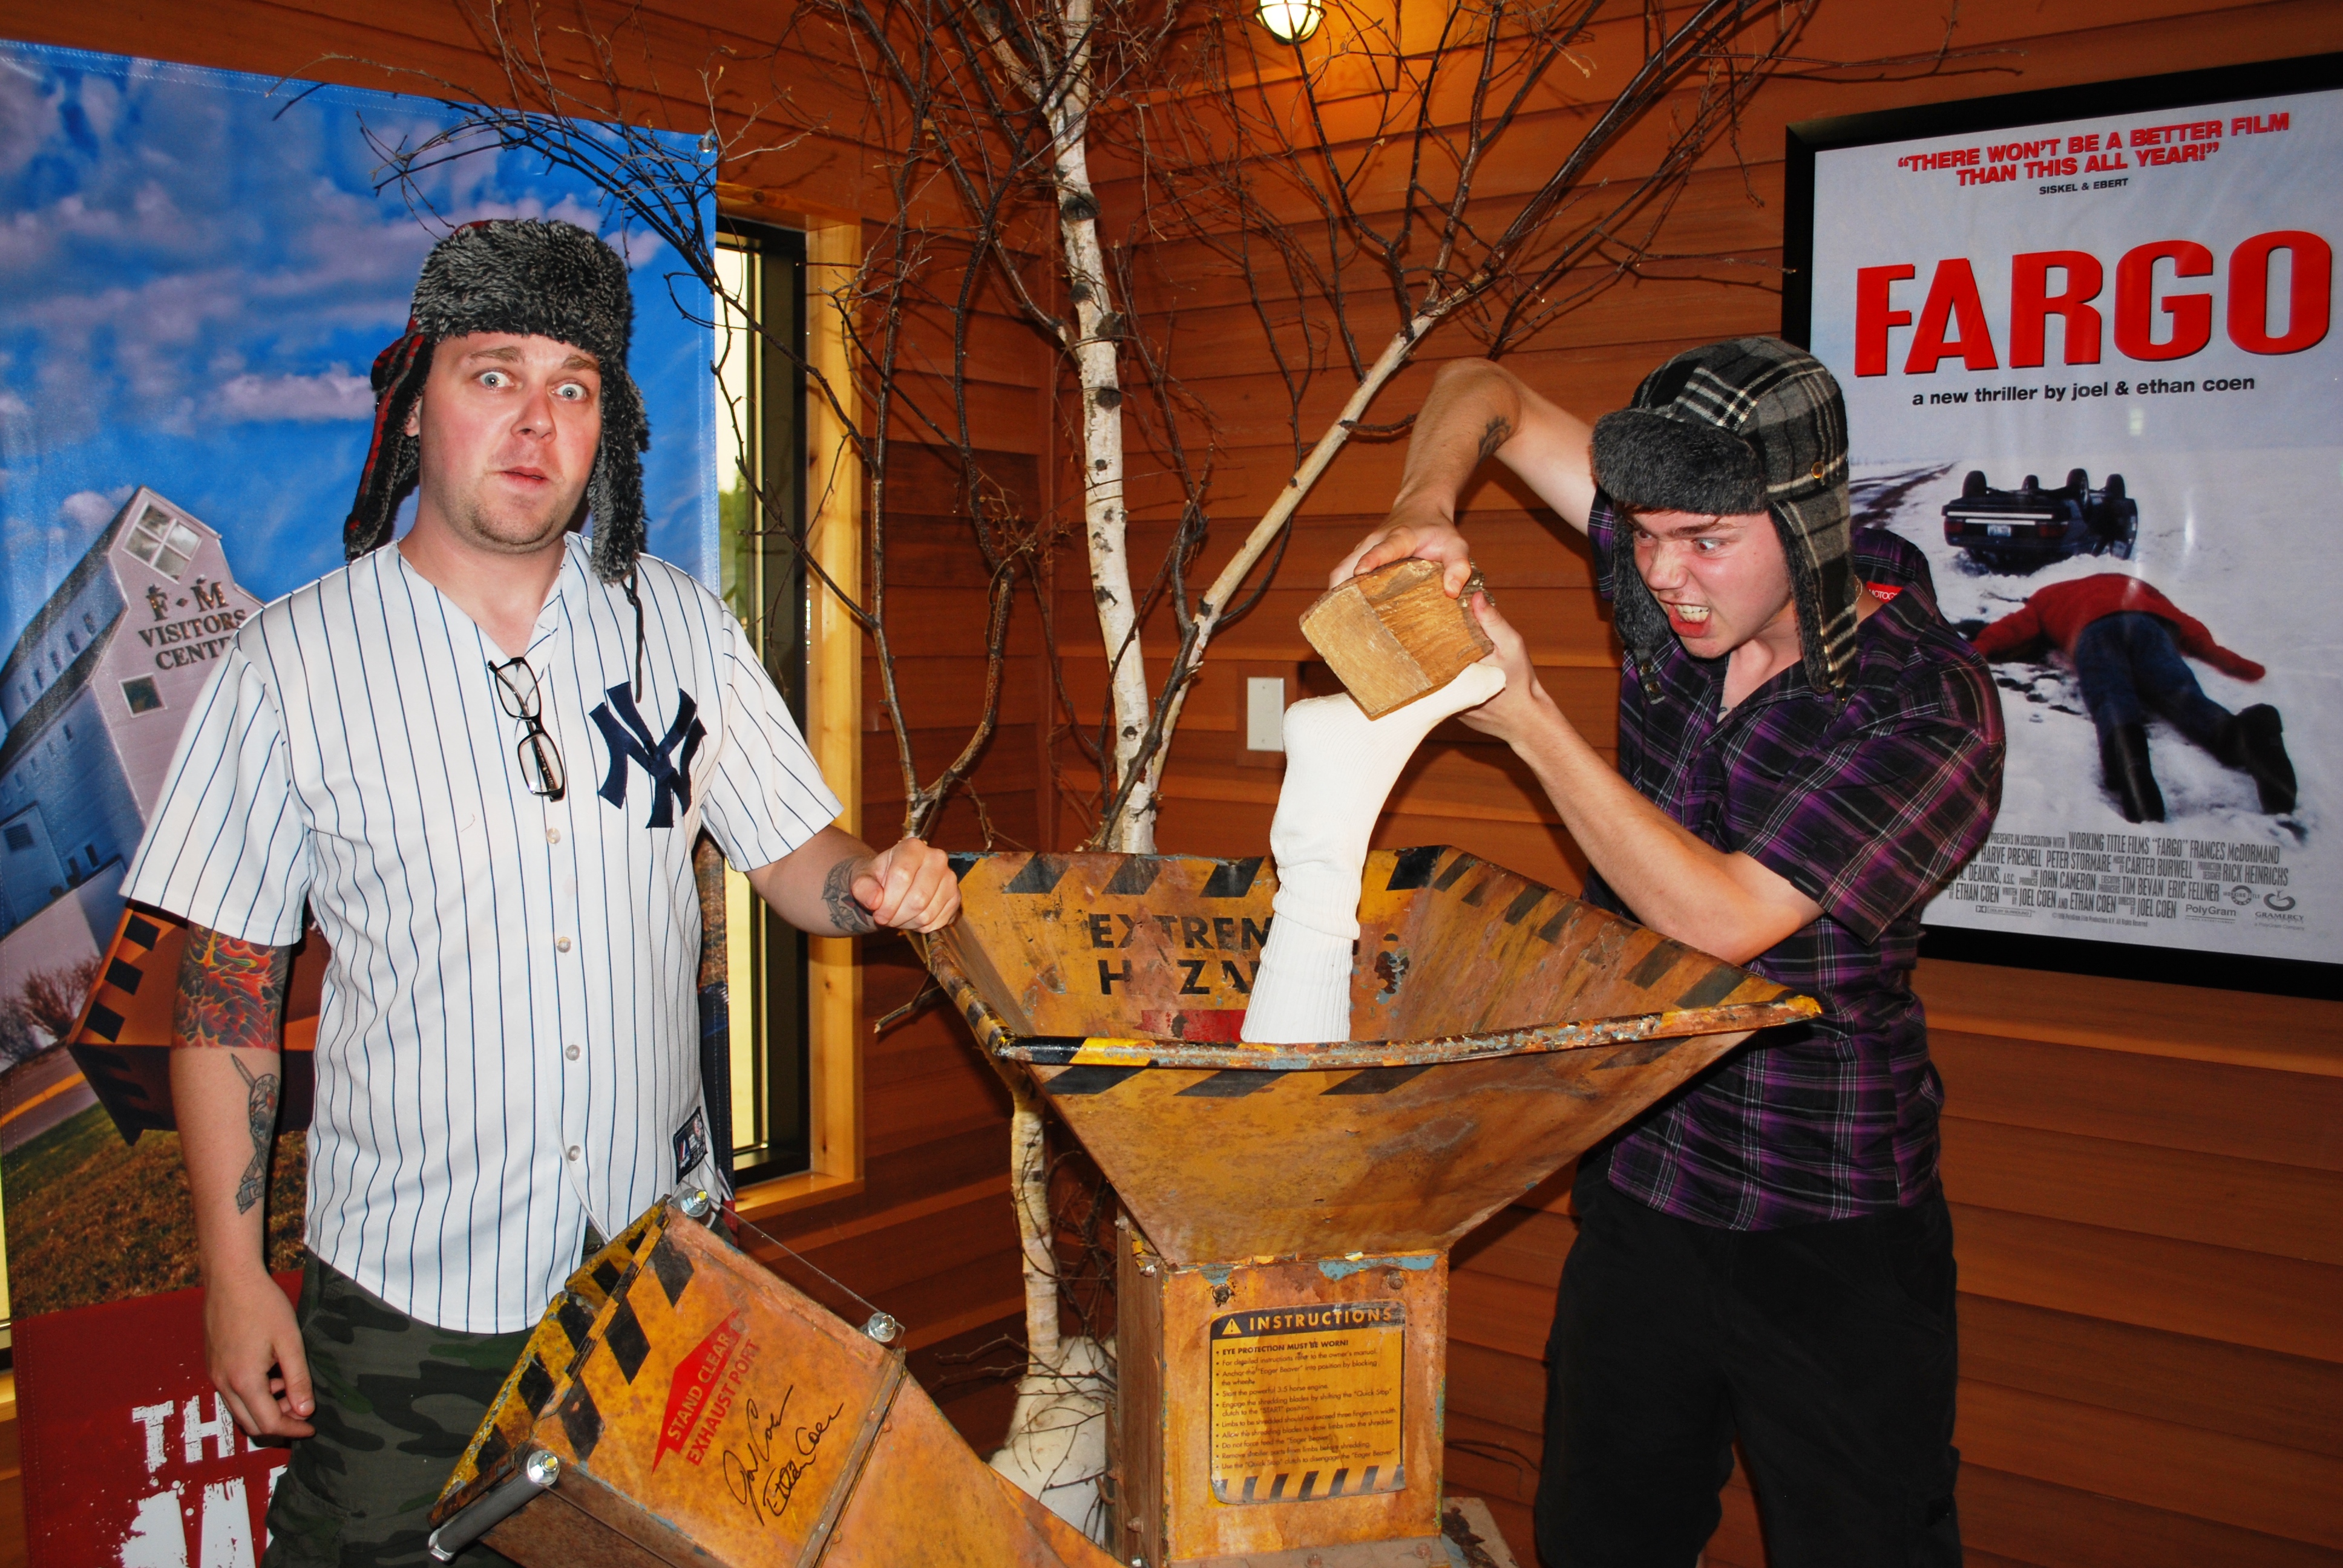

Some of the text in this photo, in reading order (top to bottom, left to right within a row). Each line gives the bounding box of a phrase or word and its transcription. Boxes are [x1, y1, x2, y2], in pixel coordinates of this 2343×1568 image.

[2068, 134, 2100, 155] BE
[2105, 132, 2124, 151] A
[2129, 120, 2223, 148] BETTER
[2230, 112, 2290, 137] FILM
[1956, 163, 2017, 186] THAN
[2025, 157, 2077, 179] THIS
[2083, 153, 2128, 172] ALL
[2039, 177, 2129, 195] SISKEL & EBERT
[1853, 229, 2333, 378] FARGO
[1912, 375, 2255, 407] a new thriller by joel & ethan coen
[138, 609, 246, 648] VISITORS
[156, 637, 231, 670] CENT
[589, 681, 707, 829] NY
[1990, 832, 2014, 846] PRESENTS
[2014, 834, 2020, 846] IN
[2020, 834, 2052, 848] ASSOCIATION
[2053, 837, 2065, 849] WITH
[2068, 831, 2105, 852] WORKING
[2107, 834, 2126, 853] TITLE
[2128, 835, 2149, 855] FILMS
[2189, 840, 2226, 860] FRANCES
[2227, 841, 2280, 864] McDORMAND
[1981, 845, 2005, 864] HARVE
[2007, 847, 2042, 867] PRESNELL
[2046, 849, 2069, 869] PETER
[2071, 852, 2112, 872] STORMARE
[2125, 855, 2155, 876] CARTER
[2157, 858, 2193, 879] BURWELL
[2223, 863, 2243, 883] RICK
[2244, 864, 2289, 886] HEINRICHS
[1955, 883, 2177, 919] ETHAN COEN JOEL COEN AND ETHAN COEN JOEL COEN
[2039, 869, 2058, 888] JOHN
[2060, 871, 2096, 891] CAMERON
[2122, 876, 2135, 895] TIM
[2137, 877, 2164, 897] BEVAN
[2168, 880, 2186, 899] ERIC
[2188, 881, 2220, 902] FELLNER
[2185, 904, 2236, 917] PolyGram
[2255, 912, 2304, 921] GRAMERCY
[1089, 912, 1273, 950] EXTREM
[1249, 1307, 1392, 1331] INSTRUCTIONS
[1237, 1344, 1285, 1354] PROTECTION
[1320, 1339, 1349, 1348] WORN!
[1260, 1355, 1293, 1364] instructions
[1318, 1362, 1342, 1371] position
[667, 1331, 733, 1441] STAND CLEAR
[686, 1339, 761, 1466] EXHAUST PORT
[1249, 1387, 1276, 1396] powerful
[1352, 1410, 1372, 1418] fingers
[132, 1391, 270, 1472] TH
